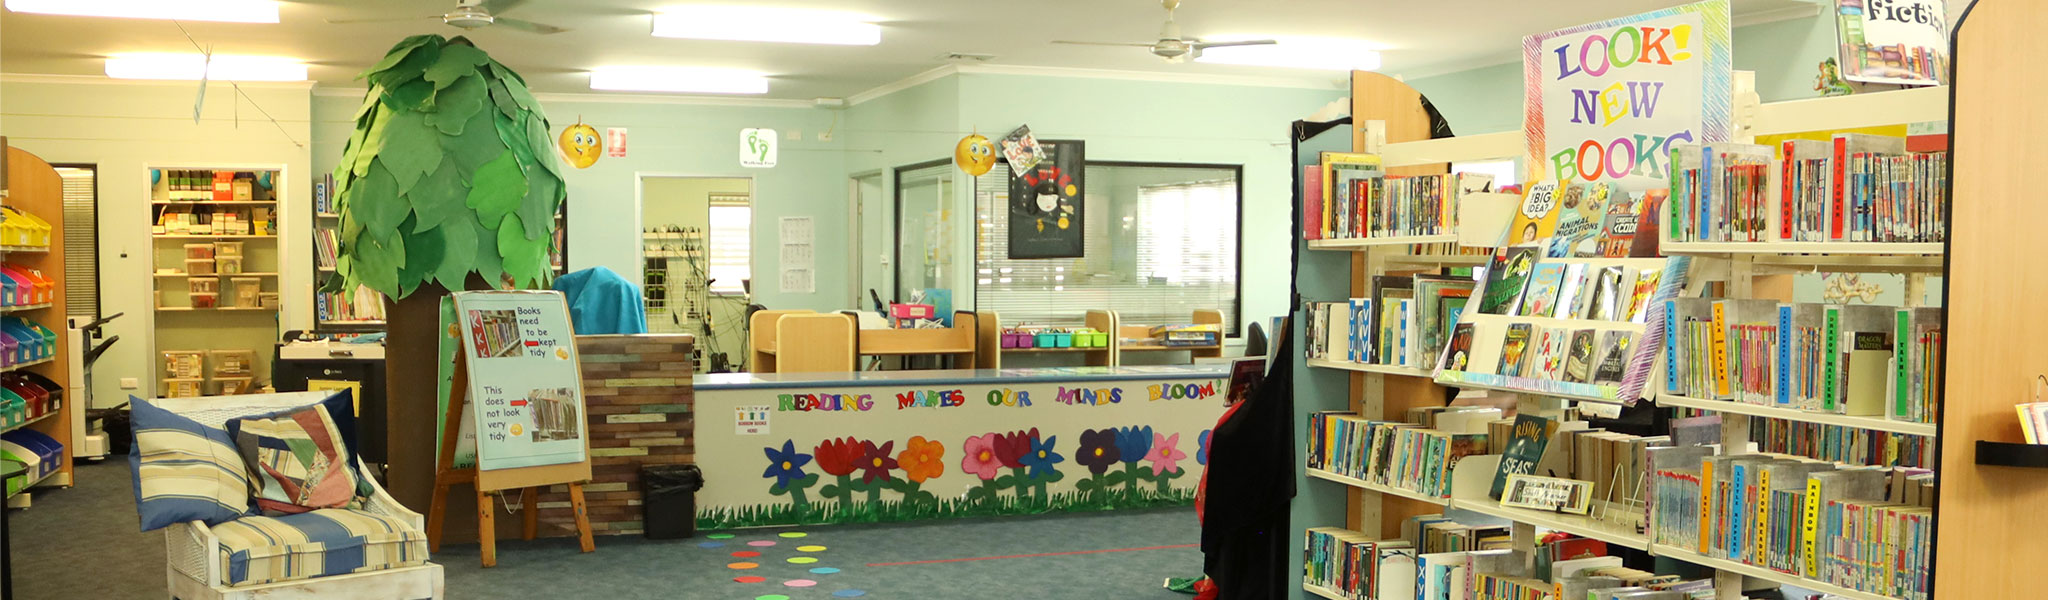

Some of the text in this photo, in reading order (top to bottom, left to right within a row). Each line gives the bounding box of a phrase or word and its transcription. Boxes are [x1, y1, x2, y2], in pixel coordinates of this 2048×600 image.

[1554, 24, 1692, 80] LOOK!
[1570, 81, 1664, 127] NEW
[1534, 192, 1552, 203] BIG
[1527, 204, 1549, 213] IDEA?
[1560, 216, 1590, 229] ANIMAL
[517, 306, 541, 315] Books
[520, 317, 539, 325] need
[537, 328, 548, 336] be
[538, 338, 556, 348] kept
[530, 348, 546, 359] tidy
[484, 386, 503, 394] This
[778, 379, 1222, 411] READING MAKES OUR MINDS BLOOM!
[485, 397, 504, 405] does
[487, 408, 520, 418] not look
[487, 421, 506, 430] very
[489, 431, 506, 442] tidy
[1515, 421, 1541, 442] RISING
[1806, 484, 1816, 531] RAINBOW
